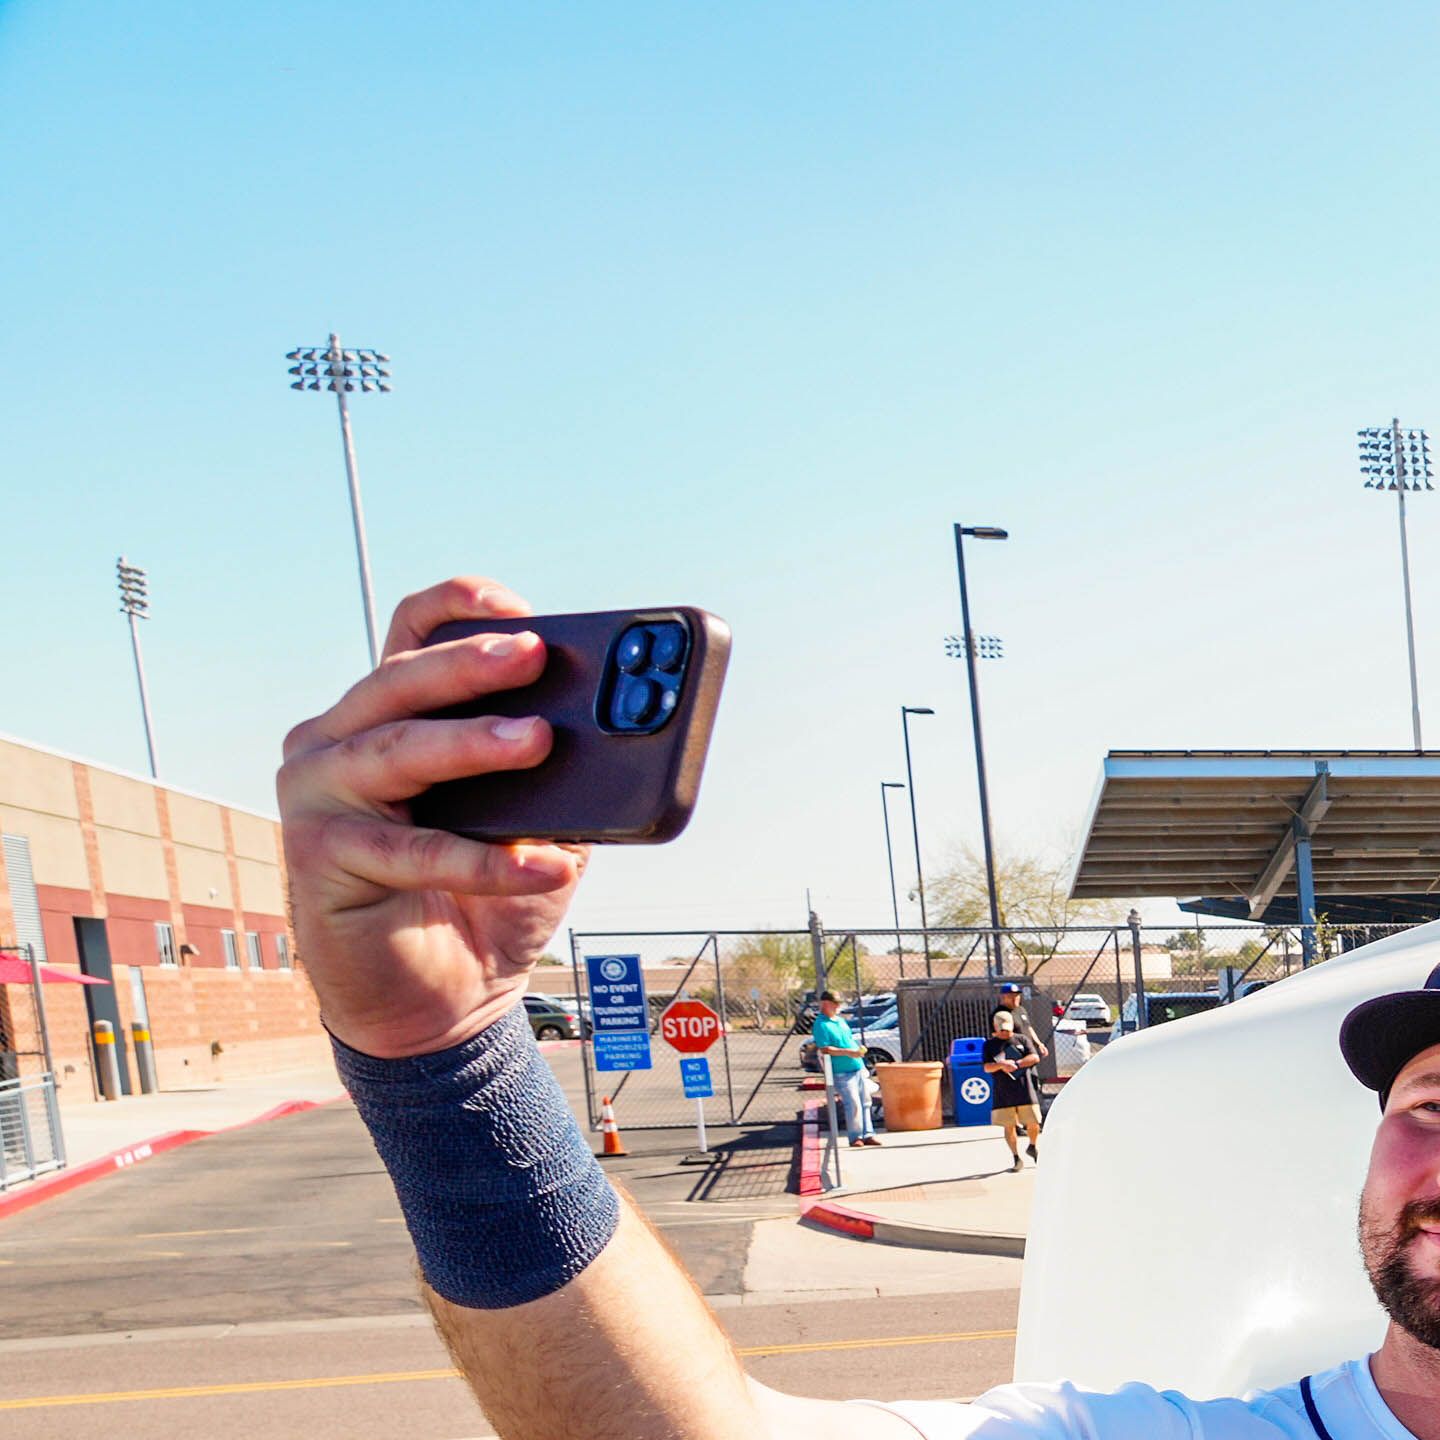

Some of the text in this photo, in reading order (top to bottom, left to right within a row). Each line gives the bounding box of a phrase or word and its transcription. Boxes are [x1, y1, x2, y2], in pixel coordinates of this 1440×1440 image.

[593, 983, 638, 993] NO EVENT
[610, 994, 624, 1004] OR
[593, 1005, 643, 1015] TOURNAMENT
[600, 1016, 639, 1026] PARKING
[664, 1016, 716, 1039] STOP
[599, 1034, 643, 1043] MARINERS
[595, 1043, 648, 1052] AUTHORIZED
[603, 1053, 642, 1061] PARKING
[687, 1063, 701, 1071] NO
